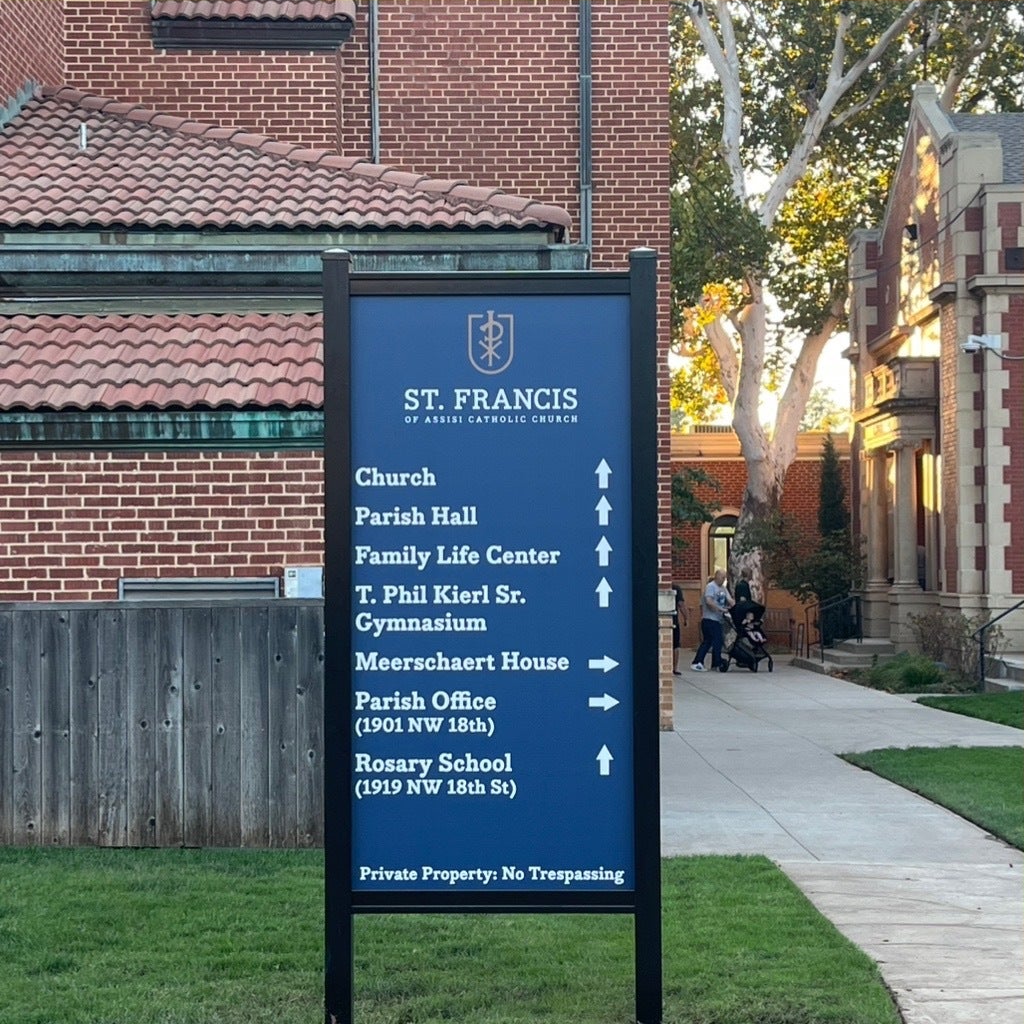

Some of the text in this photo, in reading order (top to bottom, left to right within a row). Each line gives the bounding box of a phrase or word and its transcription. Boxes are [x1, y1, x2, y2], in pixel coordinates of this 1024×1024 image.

[405, 388, 577, 410] ST. FRANCIS
[404, 415, 577, 424] OF ASSISI CATHOLIC CHURCH
[356, 467, 436, 486] Church
[355, 506, 477, 525] Parish Hall
[355, 545, 560, 570] Family Life Center
[355, 585, 525, 604] T. Phil Kierl Sr.
[356, 612, 487, 637] Gymnasium
[356, 652, 569, 671] Meerschaert House
[355, 691, 496, 710] Parish Office
[356, 717, 494, 737] (1901 NW 18th)
[355, 753, 512, 778] Rosary School
[355, 779, 516, 799] (1919 NW 18th St)
[360, 866, 624, 884] Private Property: No Trespassing
